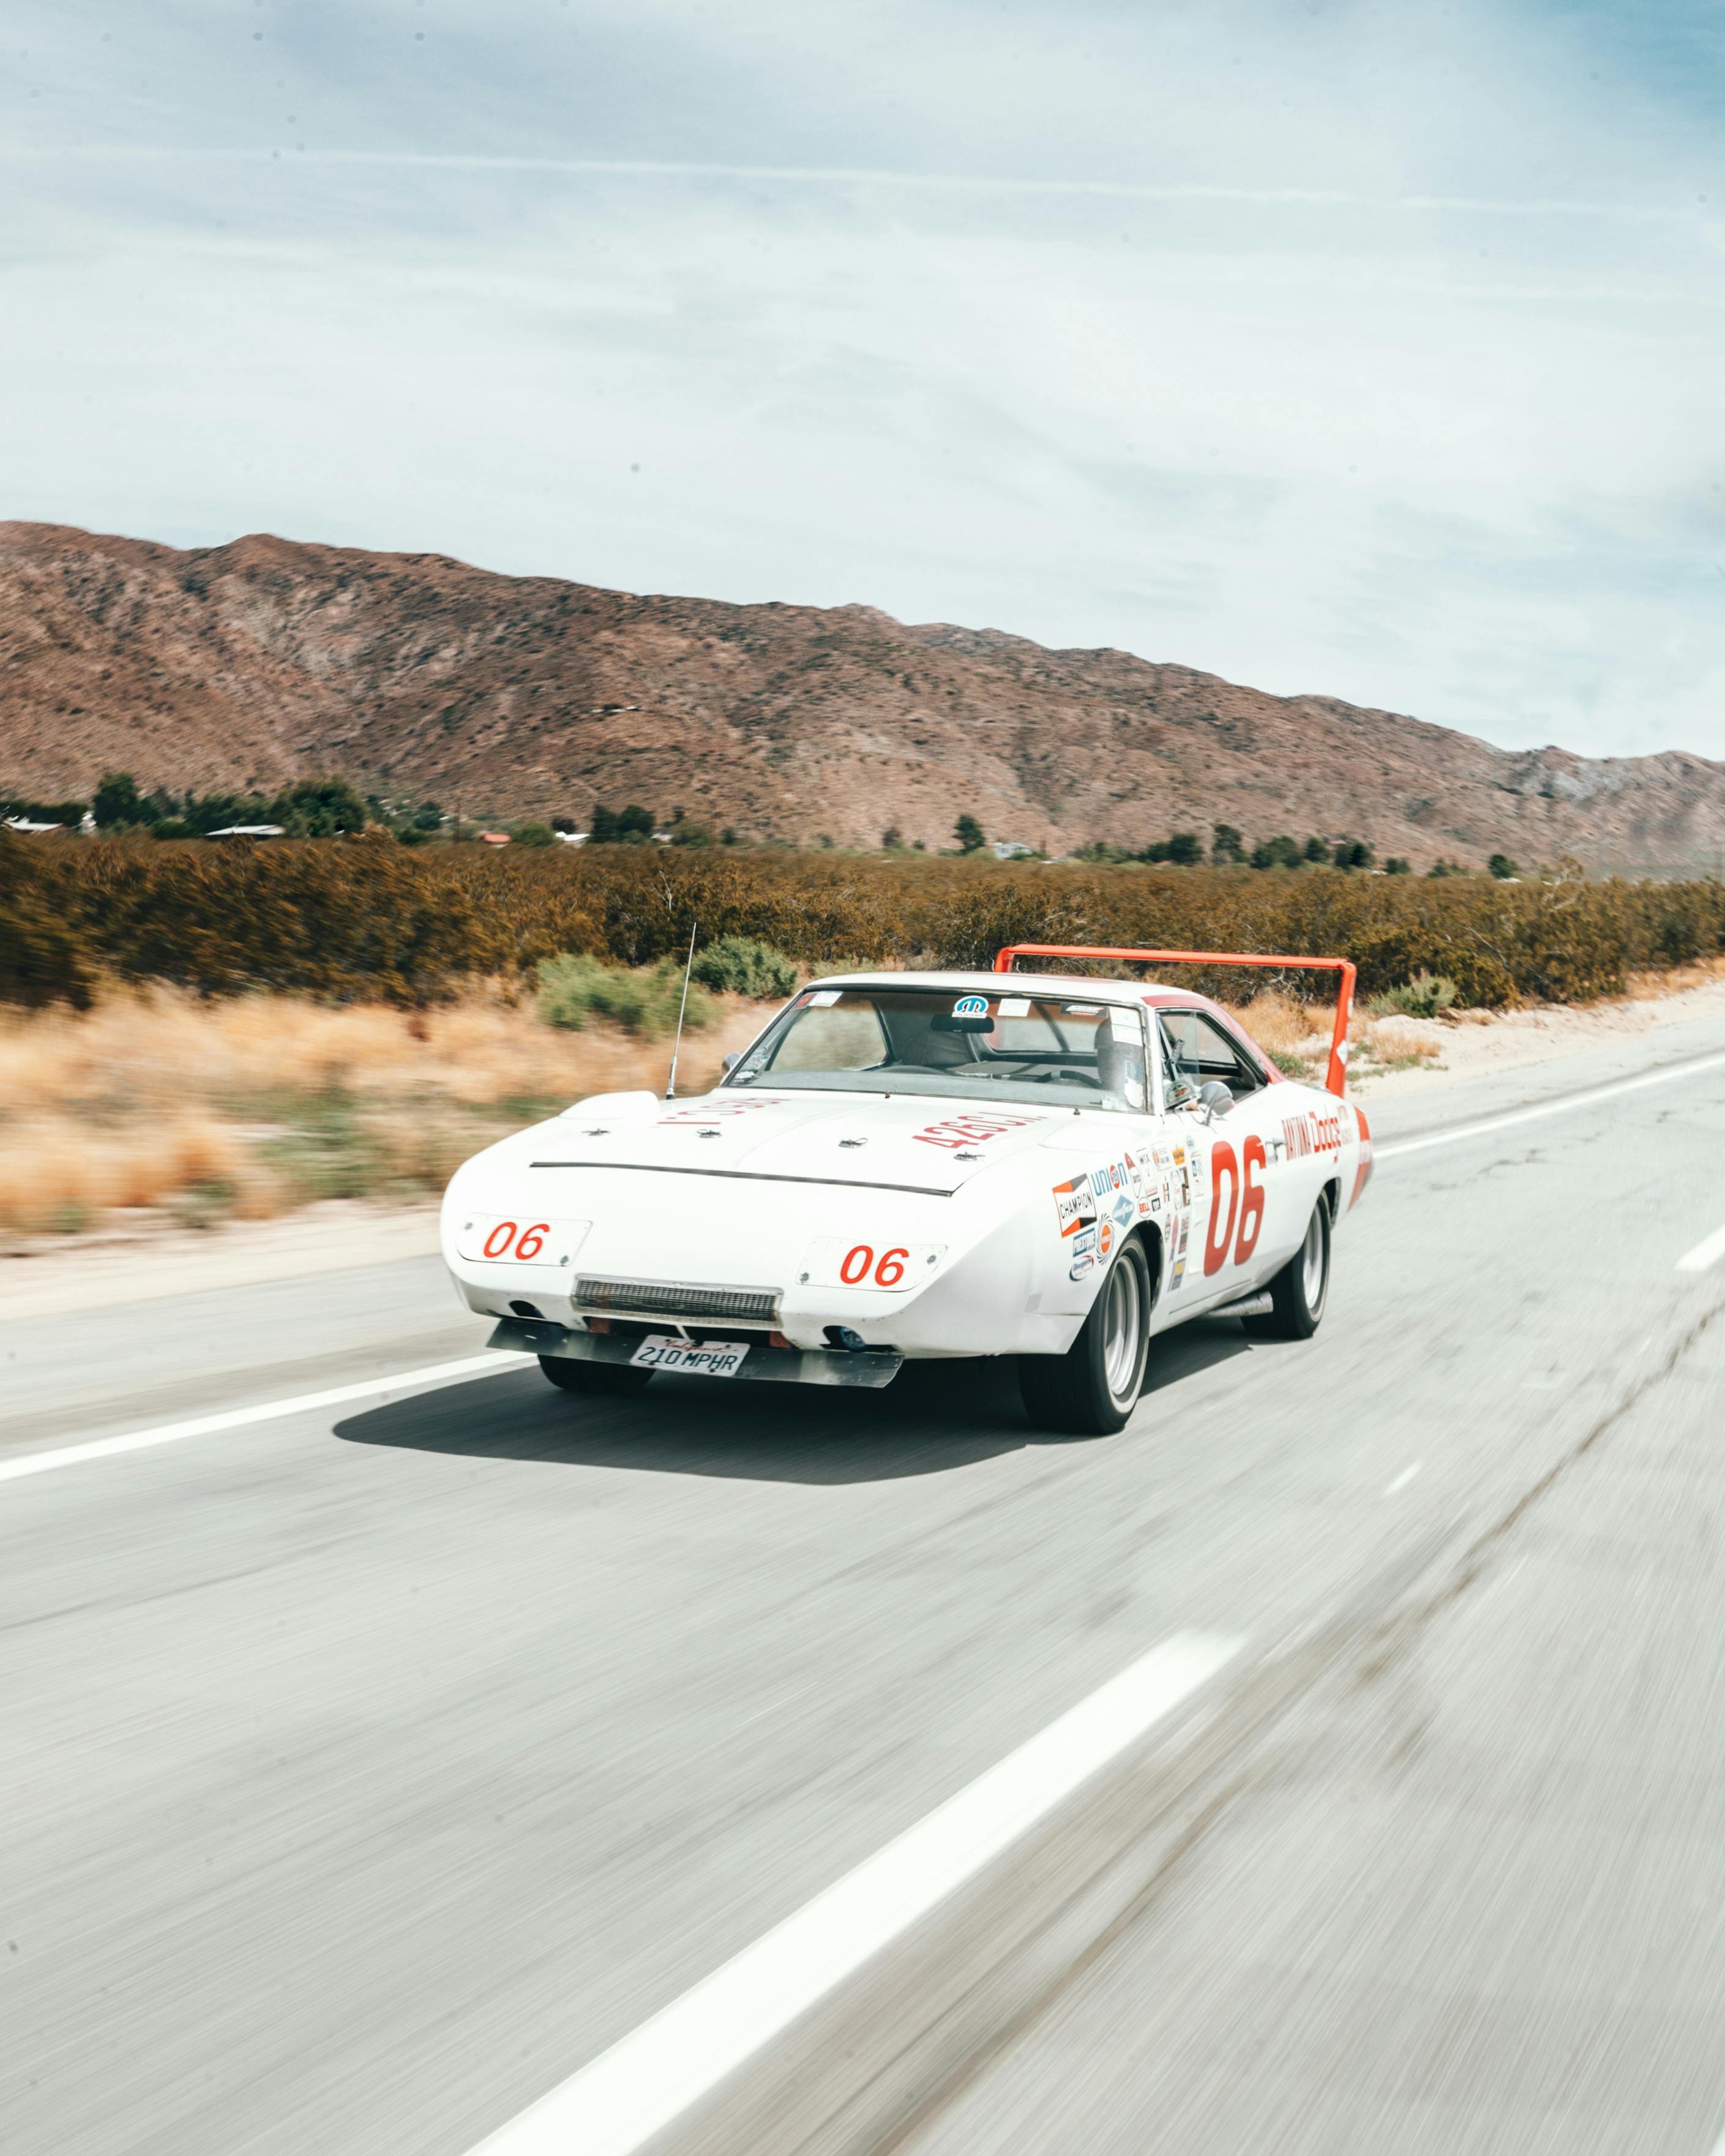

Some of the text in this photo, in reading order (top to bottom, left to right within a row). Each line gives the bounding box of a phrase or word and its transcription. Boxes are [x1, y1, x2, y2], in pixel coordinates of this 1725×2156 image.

[911, 1121, 1008, 1148] 426
[1060, 1191, 1092, 1219] CHAMPION
[1139, 1202, 1150, 1213] BELL
[1203, 1135, 1267, 1277] 06
[483, 1221, 550, 1260] 06
[840, 1245, 909, 1286] 06
